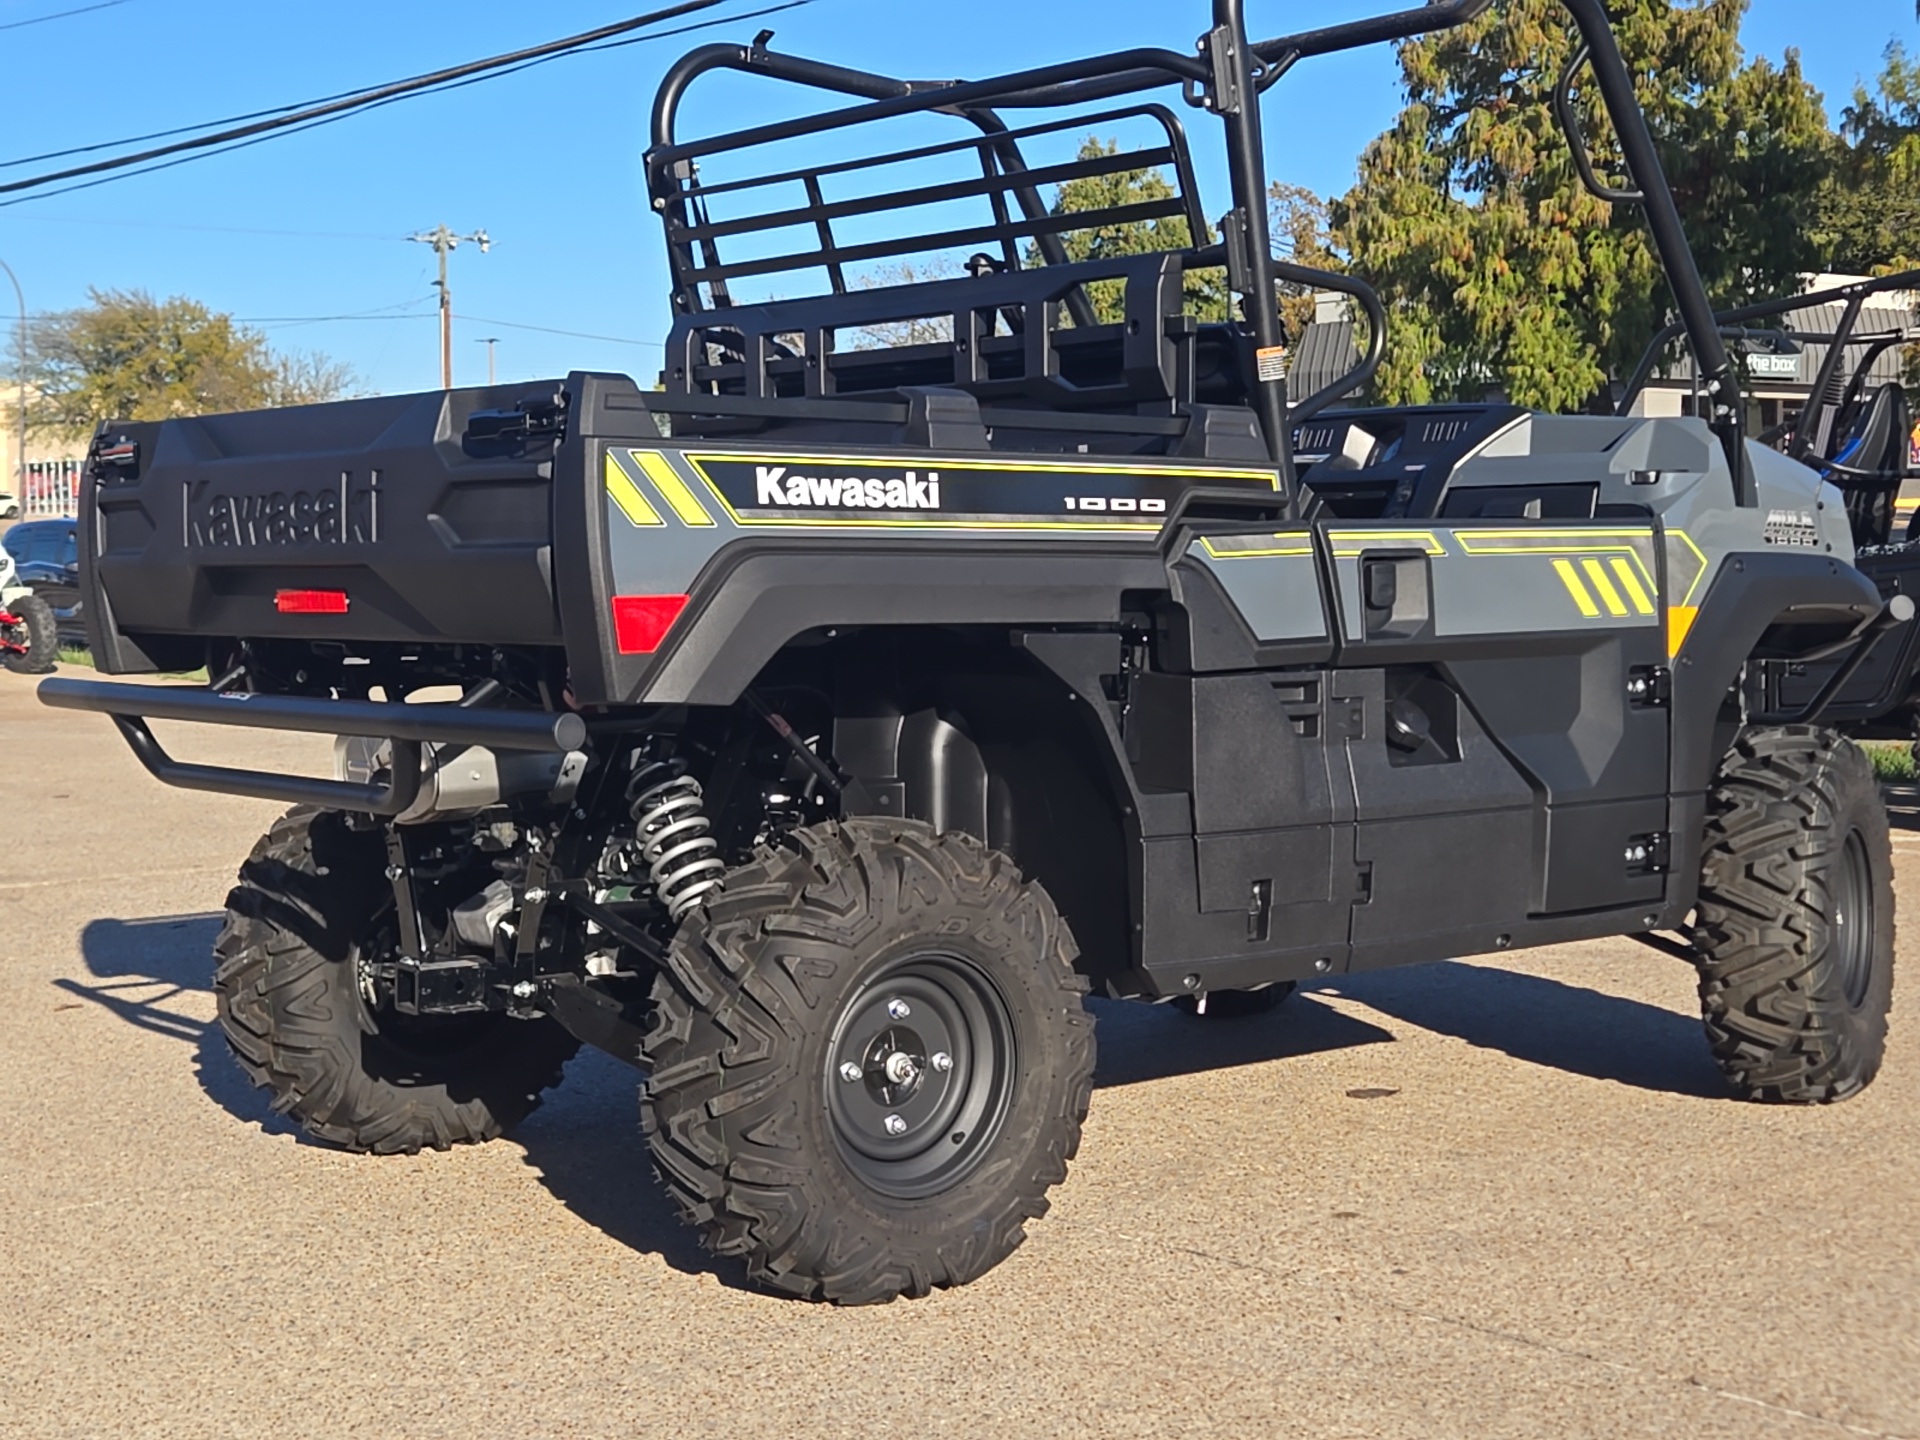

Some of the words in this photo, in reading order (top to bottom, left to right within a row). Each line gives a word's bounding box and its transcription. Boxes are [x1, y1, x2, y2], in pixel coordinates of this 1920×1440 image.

[1770, 355, 1796, 372] box
[755, 466, 940, 509] Kawasaki
[182, 469, 382, 548] Kawasaki
[1064, 496, 1166, 512] 1000
